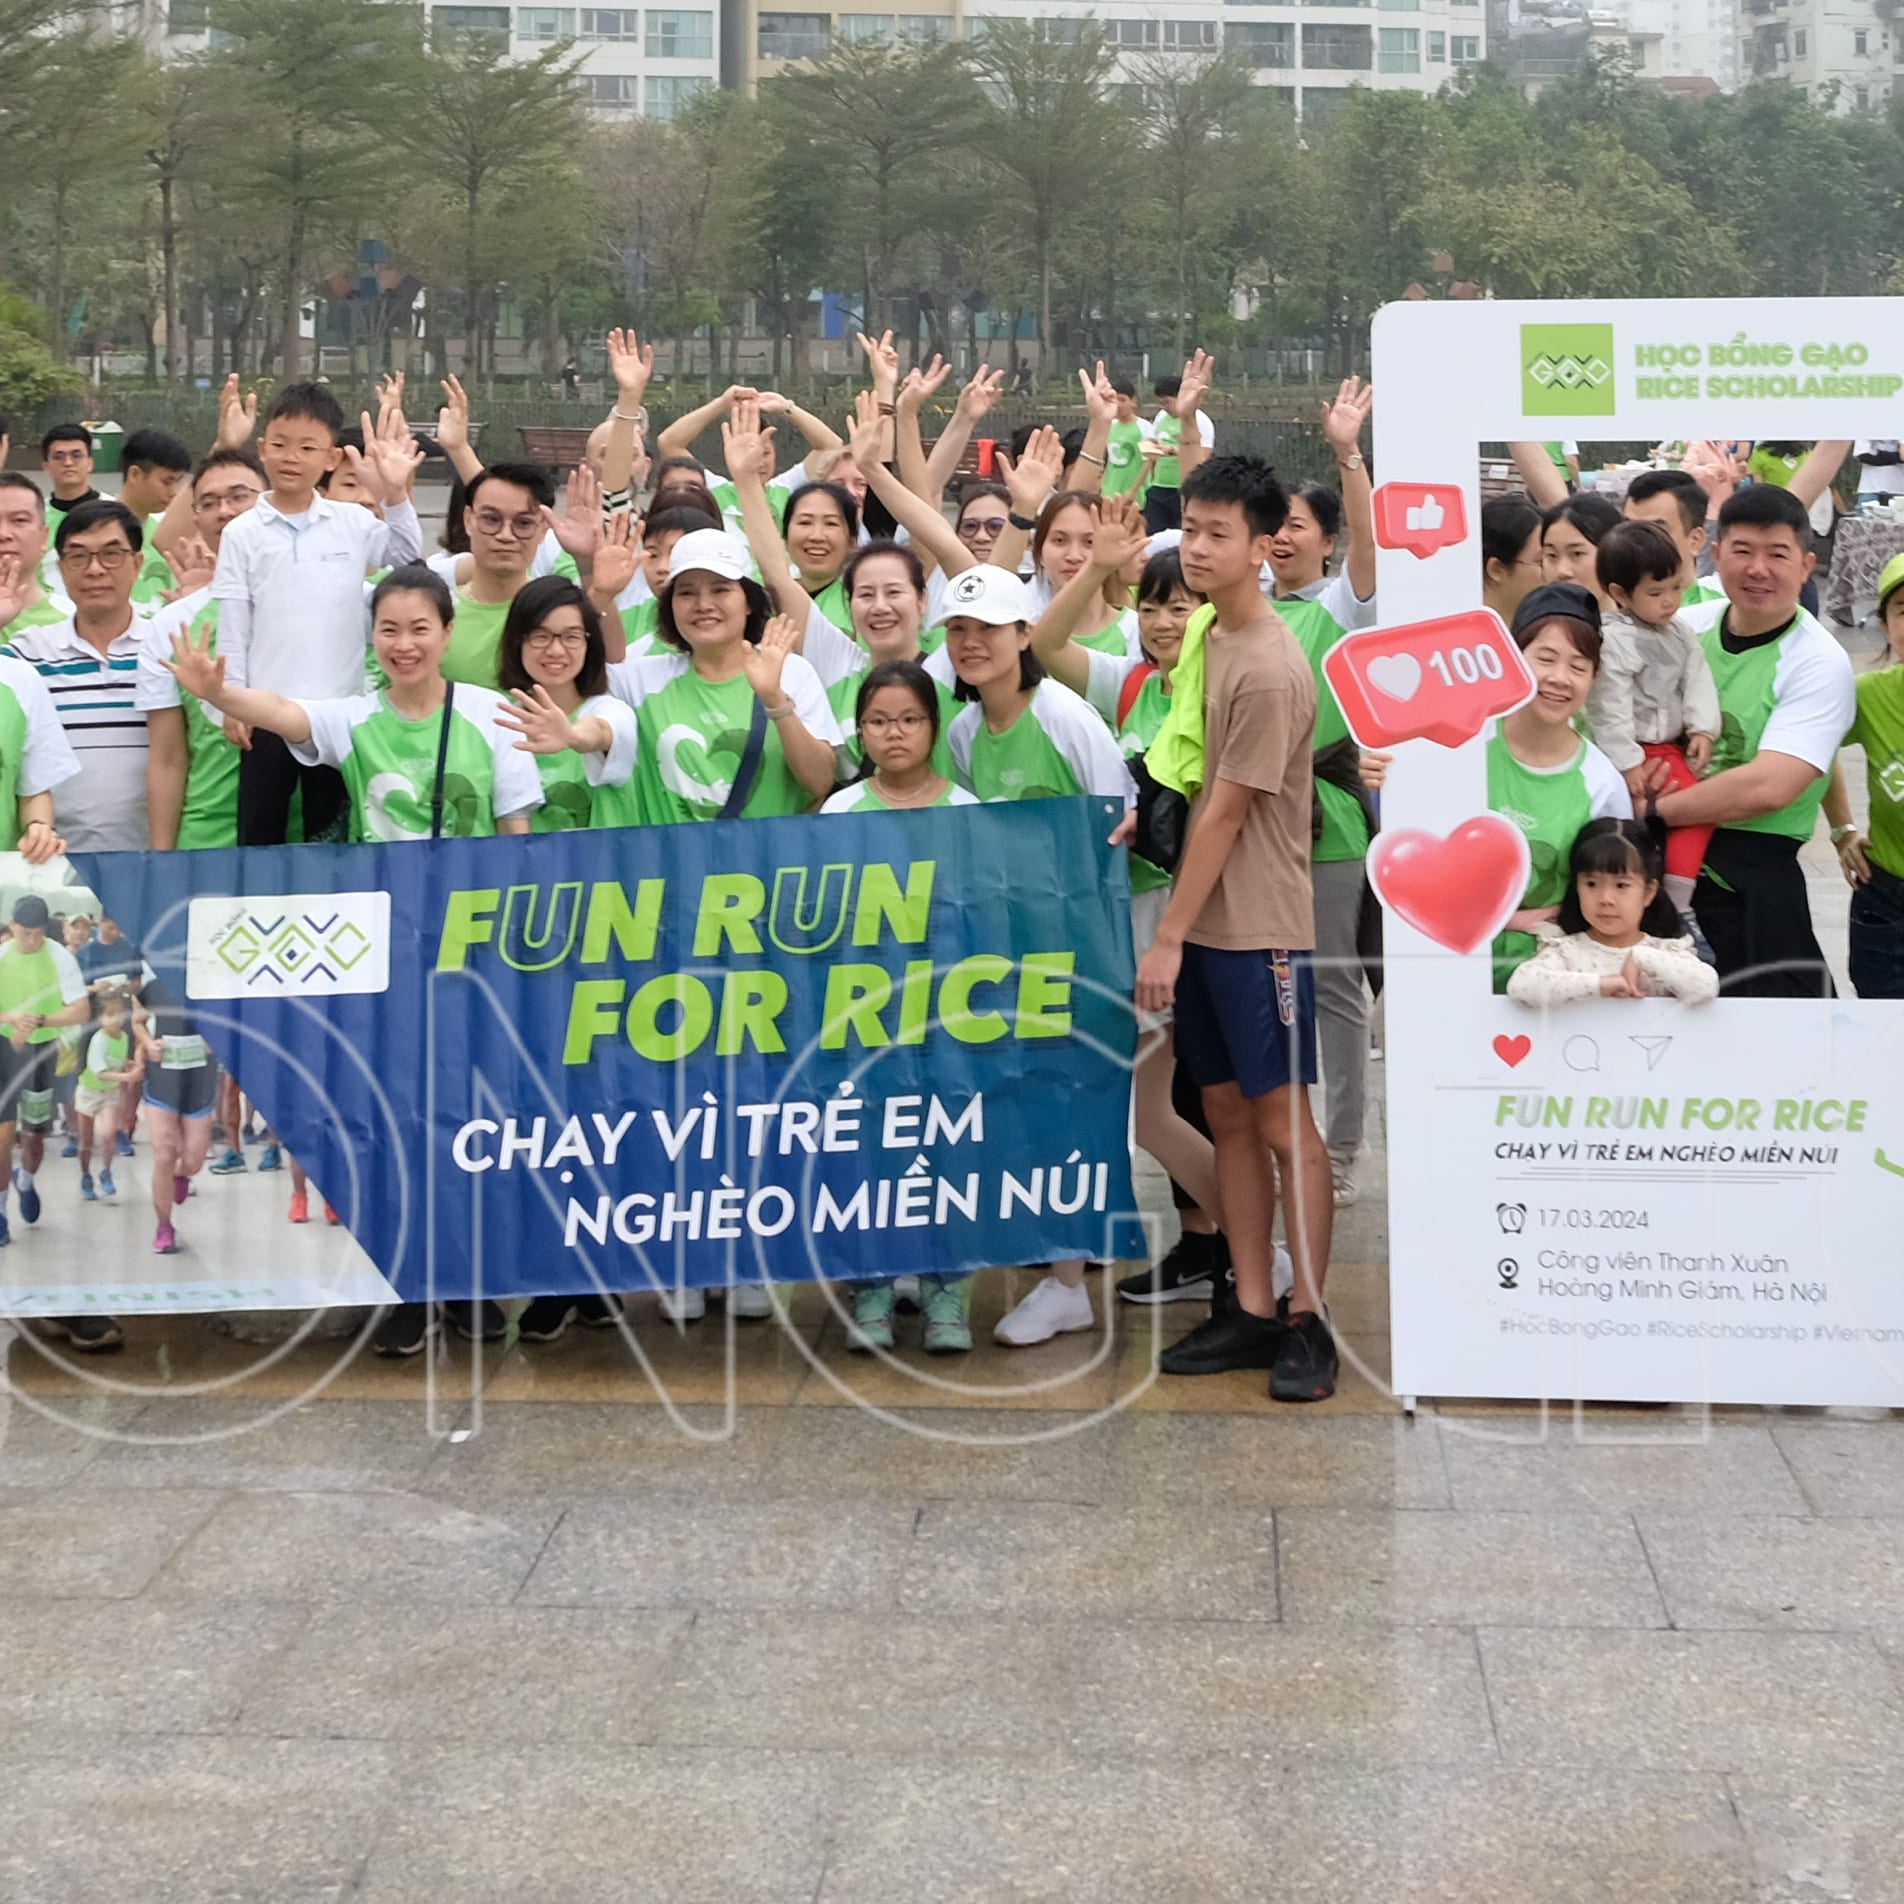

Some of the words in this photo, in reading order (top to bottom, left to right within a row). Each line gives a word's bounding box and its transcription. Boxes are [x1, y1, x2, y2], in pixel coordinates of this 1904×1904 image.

[1635, 343, 1702, 373] HỌC
[1708, 330, 1793, 367] BỔNG
[1800, 342, 1869, 373] GẠO
[1636, 374, 1700, 400] RICE
[1706, 373, 1903, 400] SCHOLARSHIP
[1428, 643, 1504, 687] 100
[436, 879, 665, 972] FUN
[693, 860, 935, 956] RUN
[562, 969, 788, 1065] FOR
[819, 951, 1076, 1051] RICE
[452, 1111, 636, 1185] CHẠY
[652, 1091, 718, 1162] VÌ
[736, 1080, 863, 1157] TRẺ
[882, 1092, 984, 1149] EM
[1495, 1095, 1573, 1128] FUN
[1584, 1096, 1669, 1129] RUN
[1680, 1097, 1762, 1131] FOR
[1773, 1098, 1869, 1133] RICE
[1495, 1142, 1552, 1163] CHẠY
[1557, 1139, 1579, 1161] VÌ
[1585, 1138, 1621, 1162] TRẺ
[1625, 1144, 1653, 1161] EM
[1659, 1140, 1736, 1163] NGHÈO
[564, 1174, 795, 1247] NGHÈO
[812, 1152, 980, 1234] MIỀN
[999, 1149, 1109, 1220] NÚI
[1539, 1208, 1649, 1229] 17.03.2024
[1537, 1250, 1600, 1274] Công
[1605, 1251, 1652, 1271] viên
[1657, 1252, 1725, 1272] Thanh
[1731, 1254, 1789, 1274] Xuân
[1537, 1277, 1613, 1302] Hoàng
[1619, 1279, 1673, 1299] Minh
[1752, 1281, 1785, 1301] Hà
[1790, 1282, 1829, 1305] Nội
